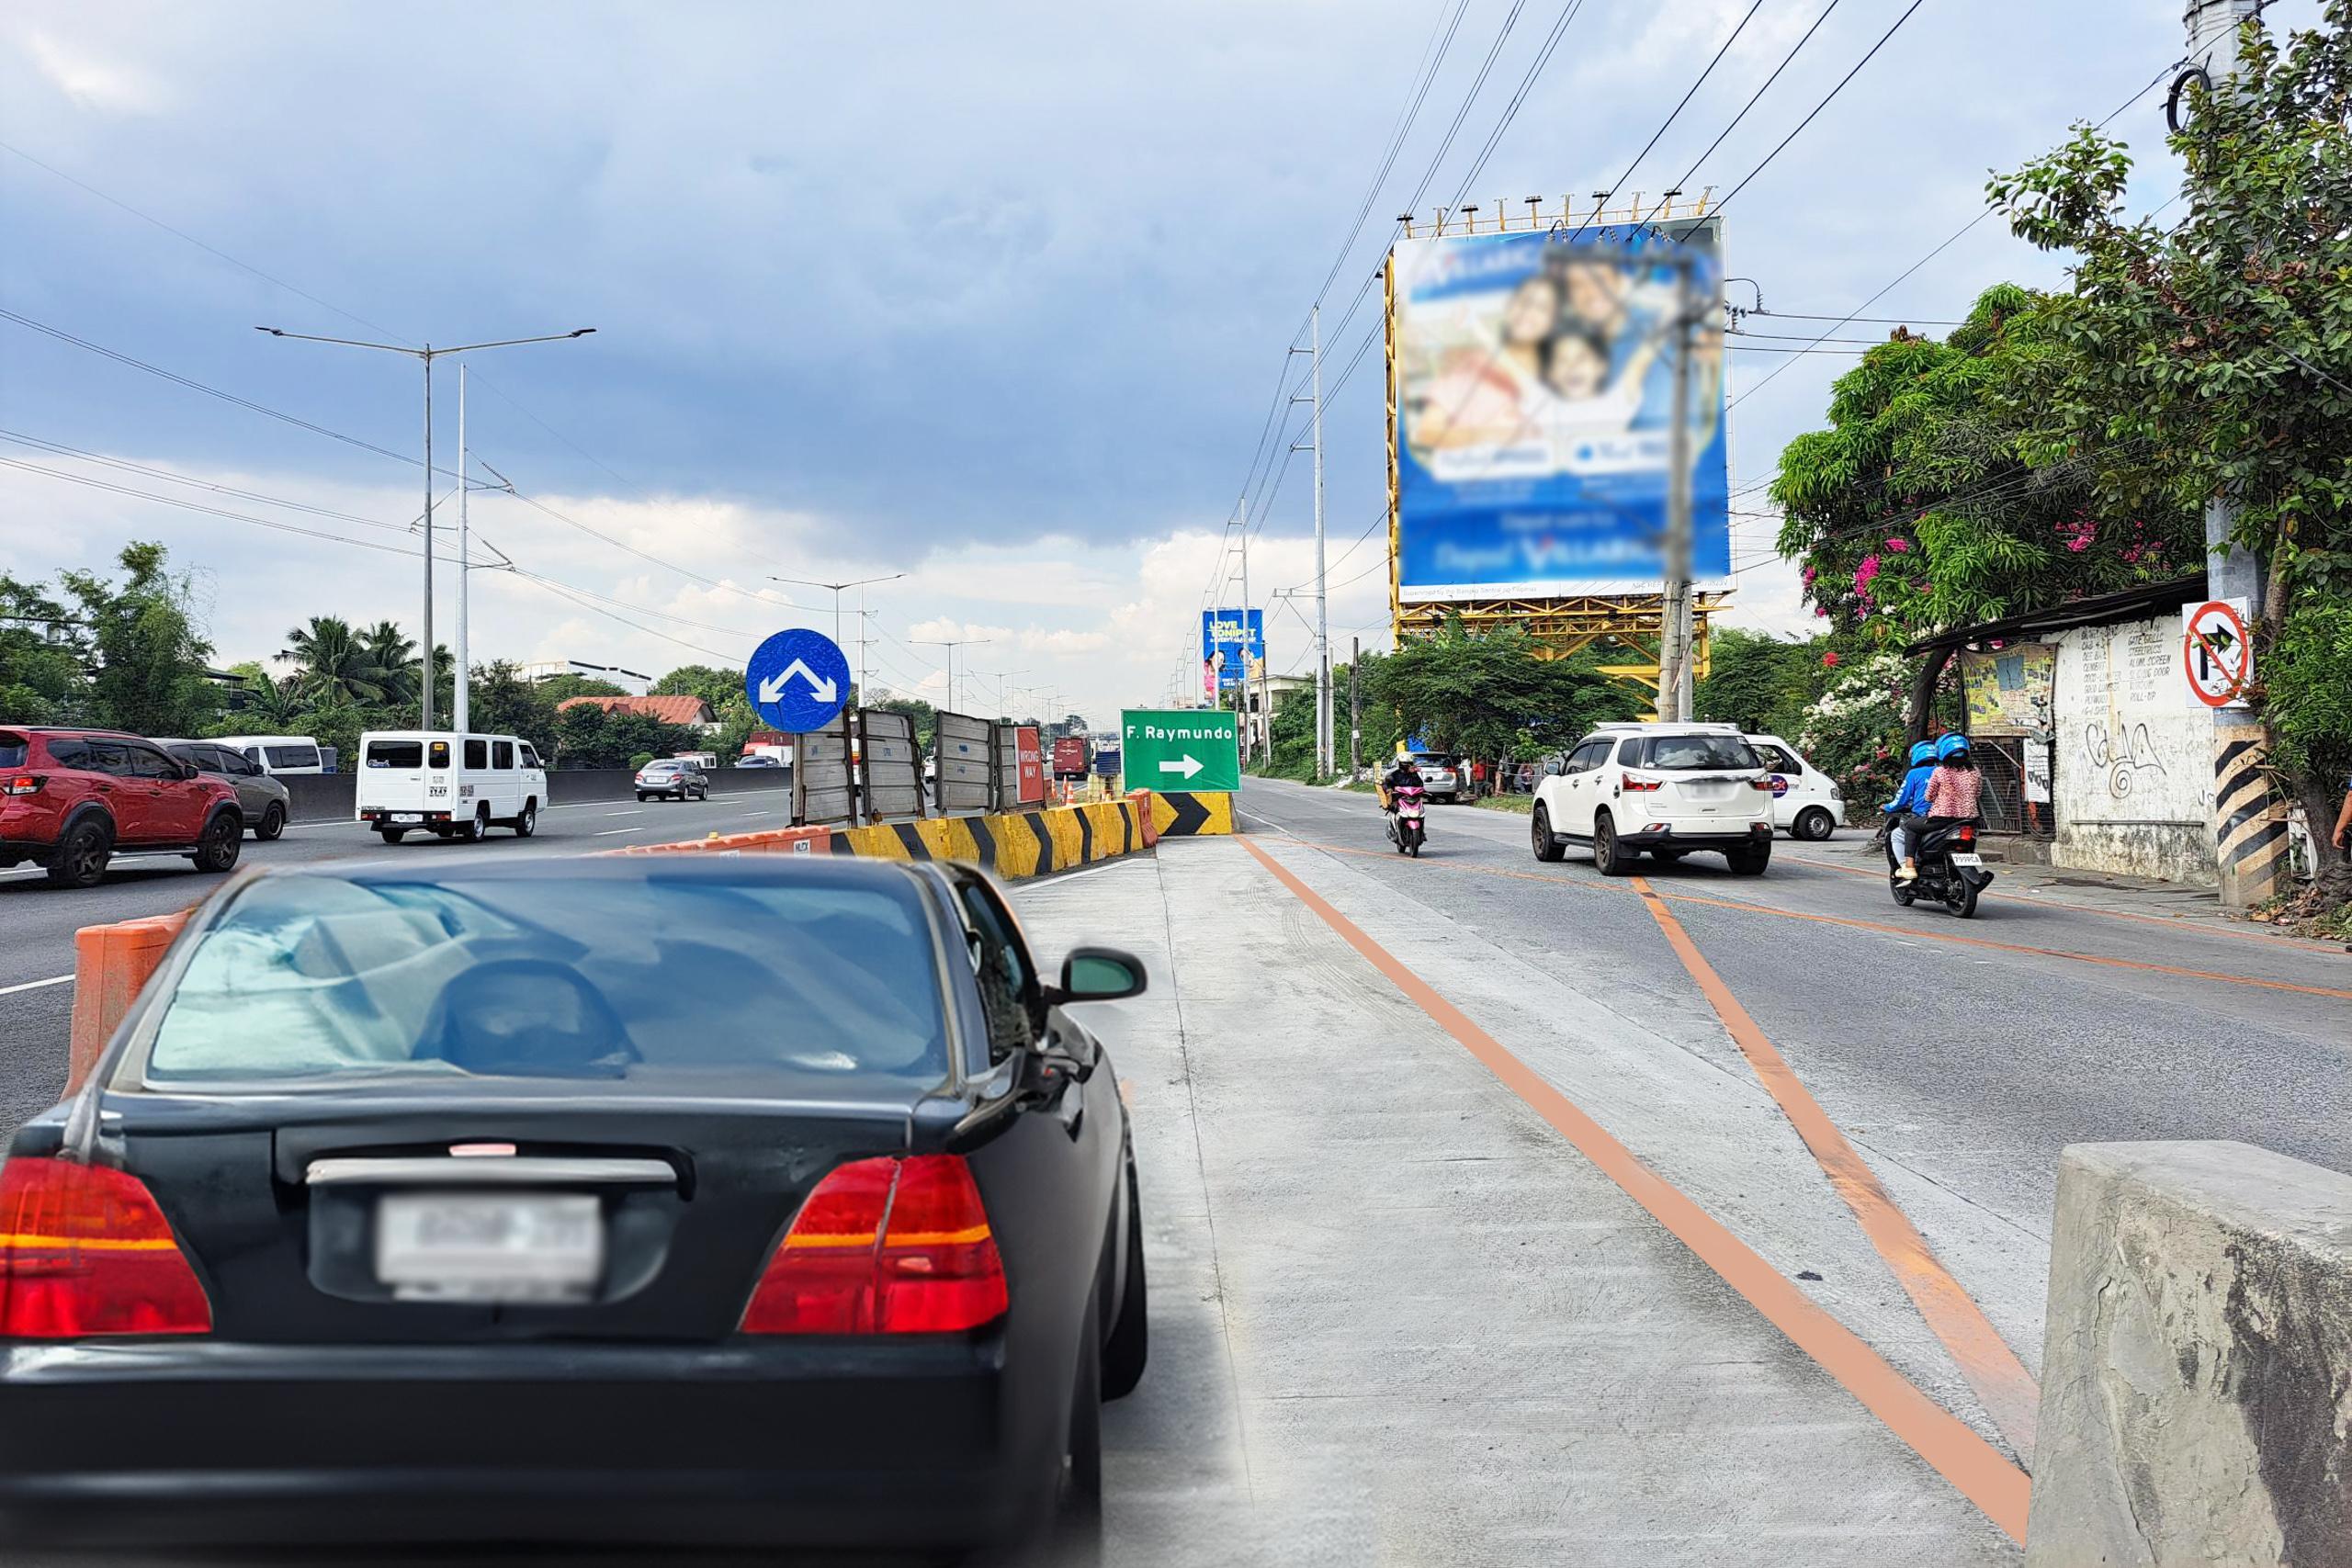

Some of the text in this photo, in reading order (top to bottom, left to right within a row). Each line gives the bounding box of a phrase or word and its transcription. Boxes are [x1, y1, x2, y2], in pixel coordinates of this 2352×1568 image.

[1126, 726, 1233, 742] F. Raymundo
[1020, 750, 1039, 763] WRONG
[1024, 765, 1036, 779] WAY
